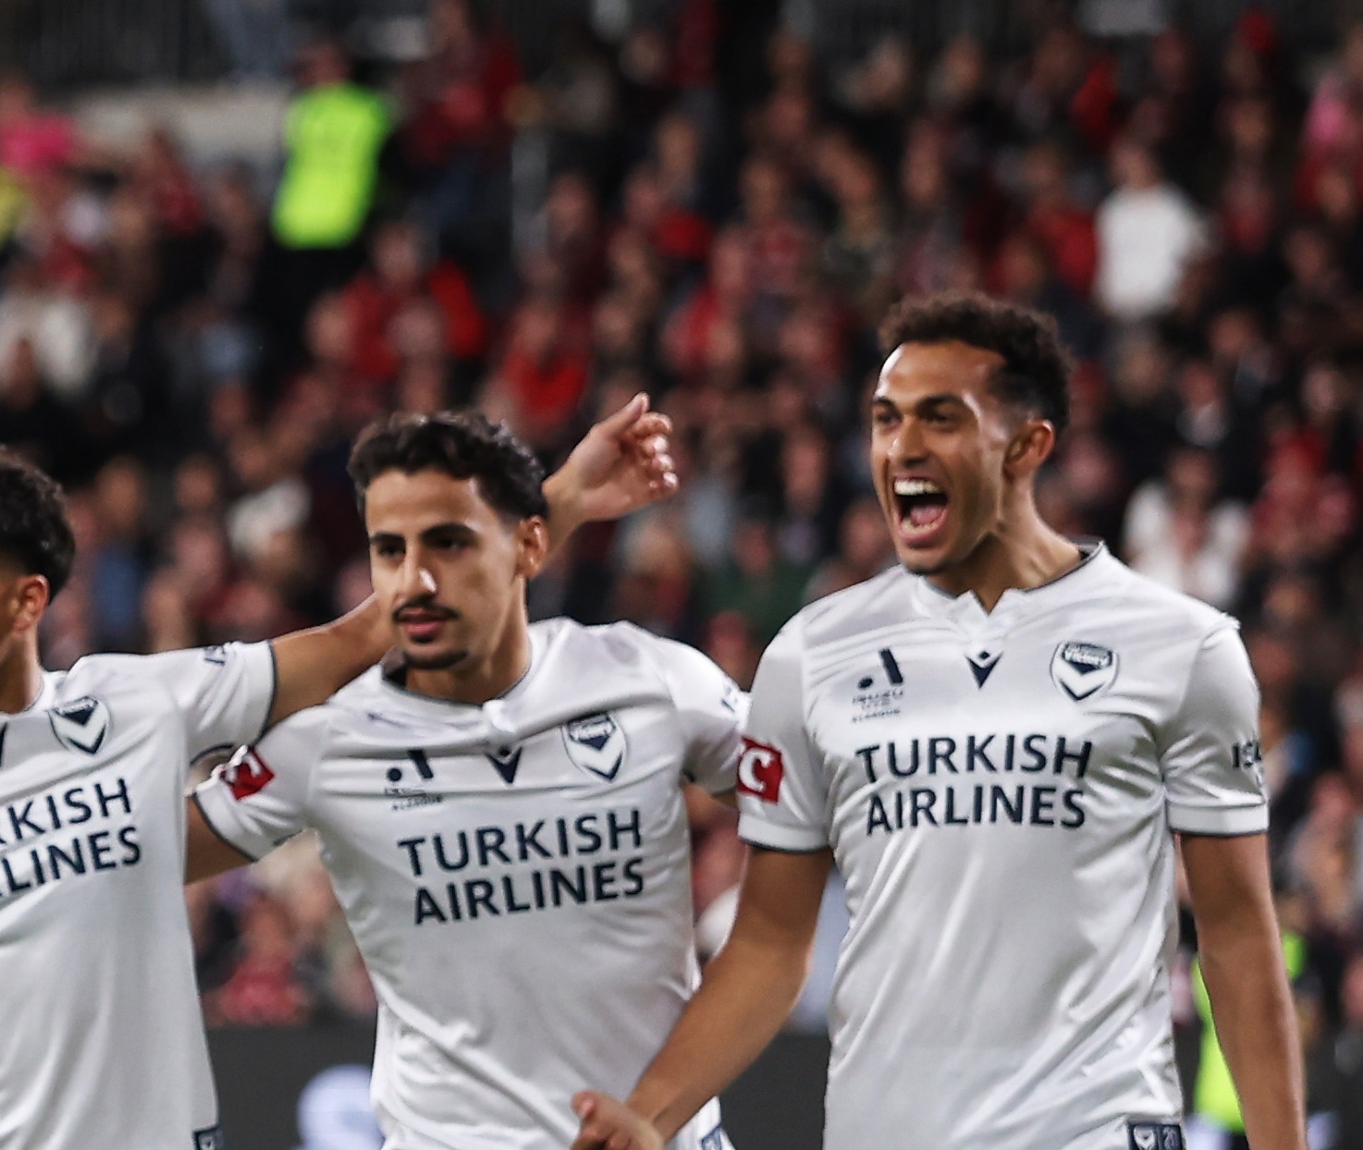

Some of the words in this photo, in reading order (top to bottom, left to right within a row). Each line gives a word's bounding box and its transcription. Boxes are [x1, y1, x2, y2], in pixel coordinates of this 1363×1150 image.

[854, 733, 1094, 784] TURKISH
[866, 784, 1087, 837] AIRLINES
[397, 809, 642, 877] TURKISH
[414, 857, 646, 926] AIRLINES
